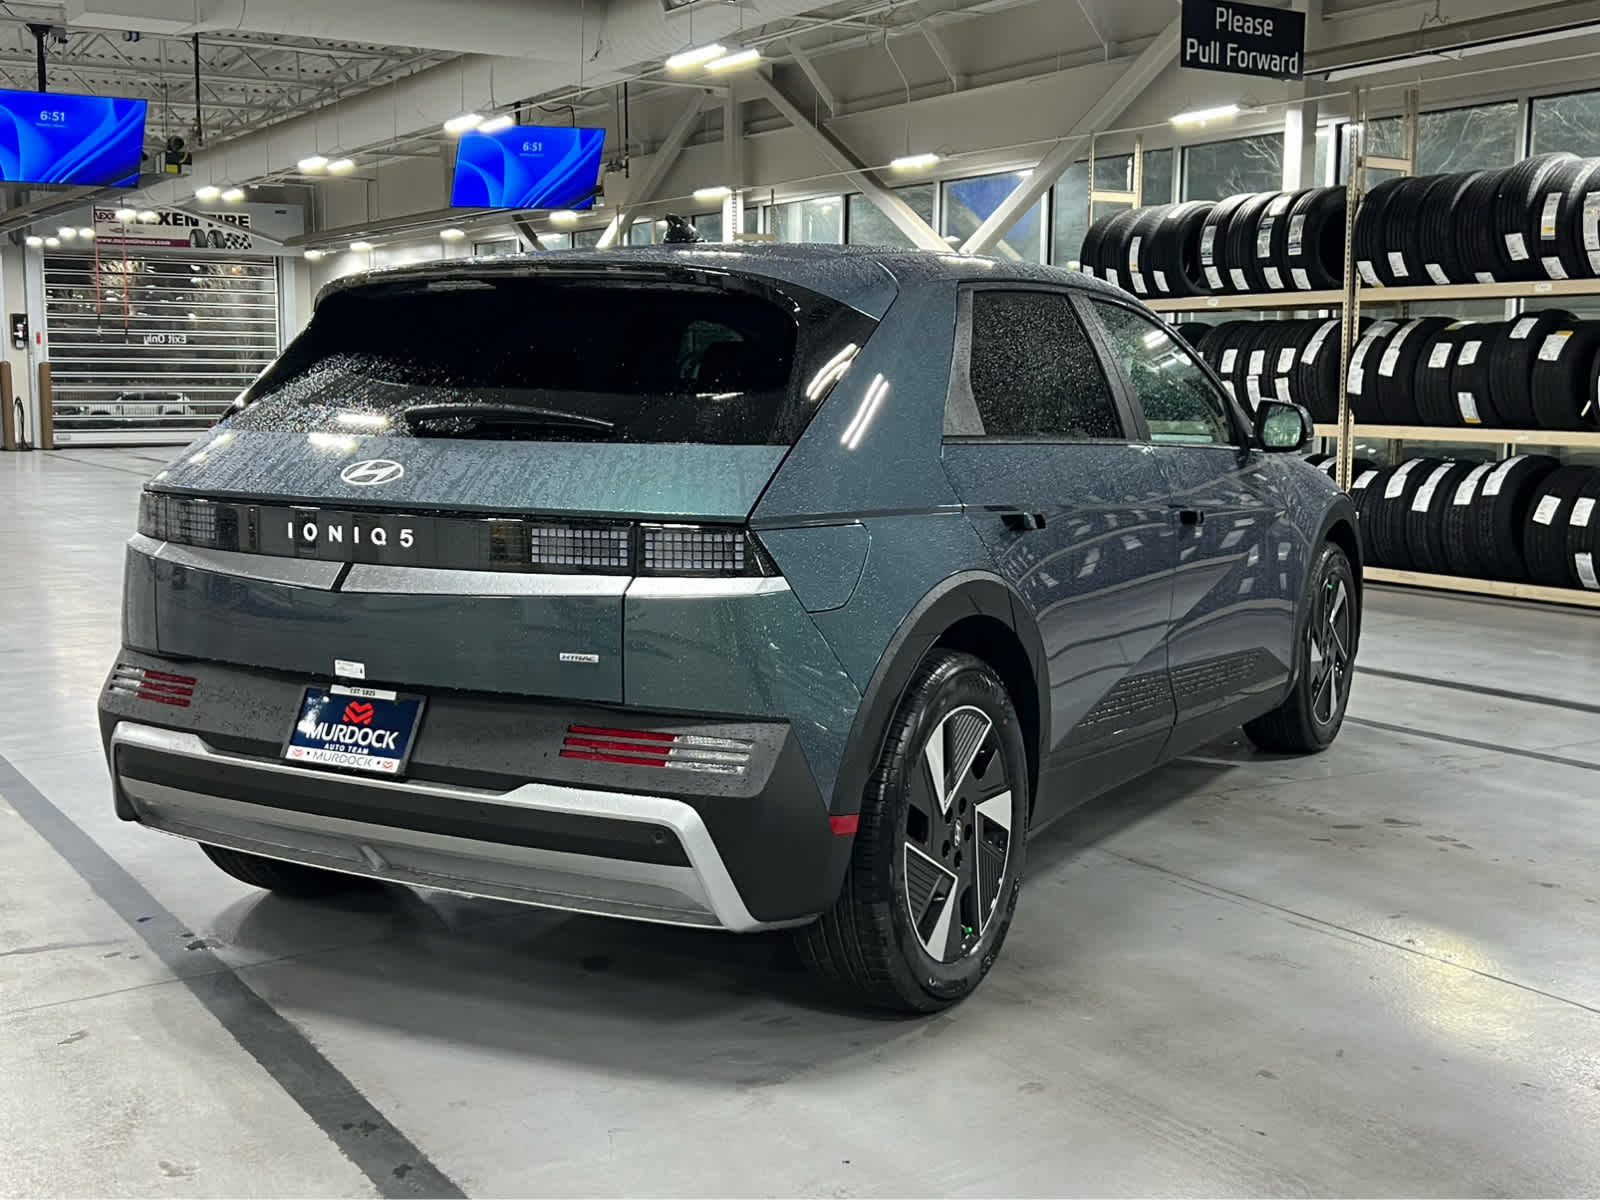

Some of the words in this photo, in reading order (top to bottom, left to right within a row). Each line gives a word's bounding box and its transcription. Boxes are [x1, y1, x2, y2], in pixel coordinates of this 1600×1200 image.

[1215, 6, 1274, 37] Please
[1185, 37, 1220, 65] Pull
[1226, 42, 1299, 74] Forward
[40, 110, 65, 122] 6:51
[522, 141, 543, 152] 6:51
[287, 521, 387, 546] IONIQ
[400, 528, 414, 548] 5
[304, 722, 400, 751] MURDOCK
[313, 750, 374, 769] MURDOCK
[323, 742, 346, 753] AUTO
[347, 745, 370, 756] TEAM
